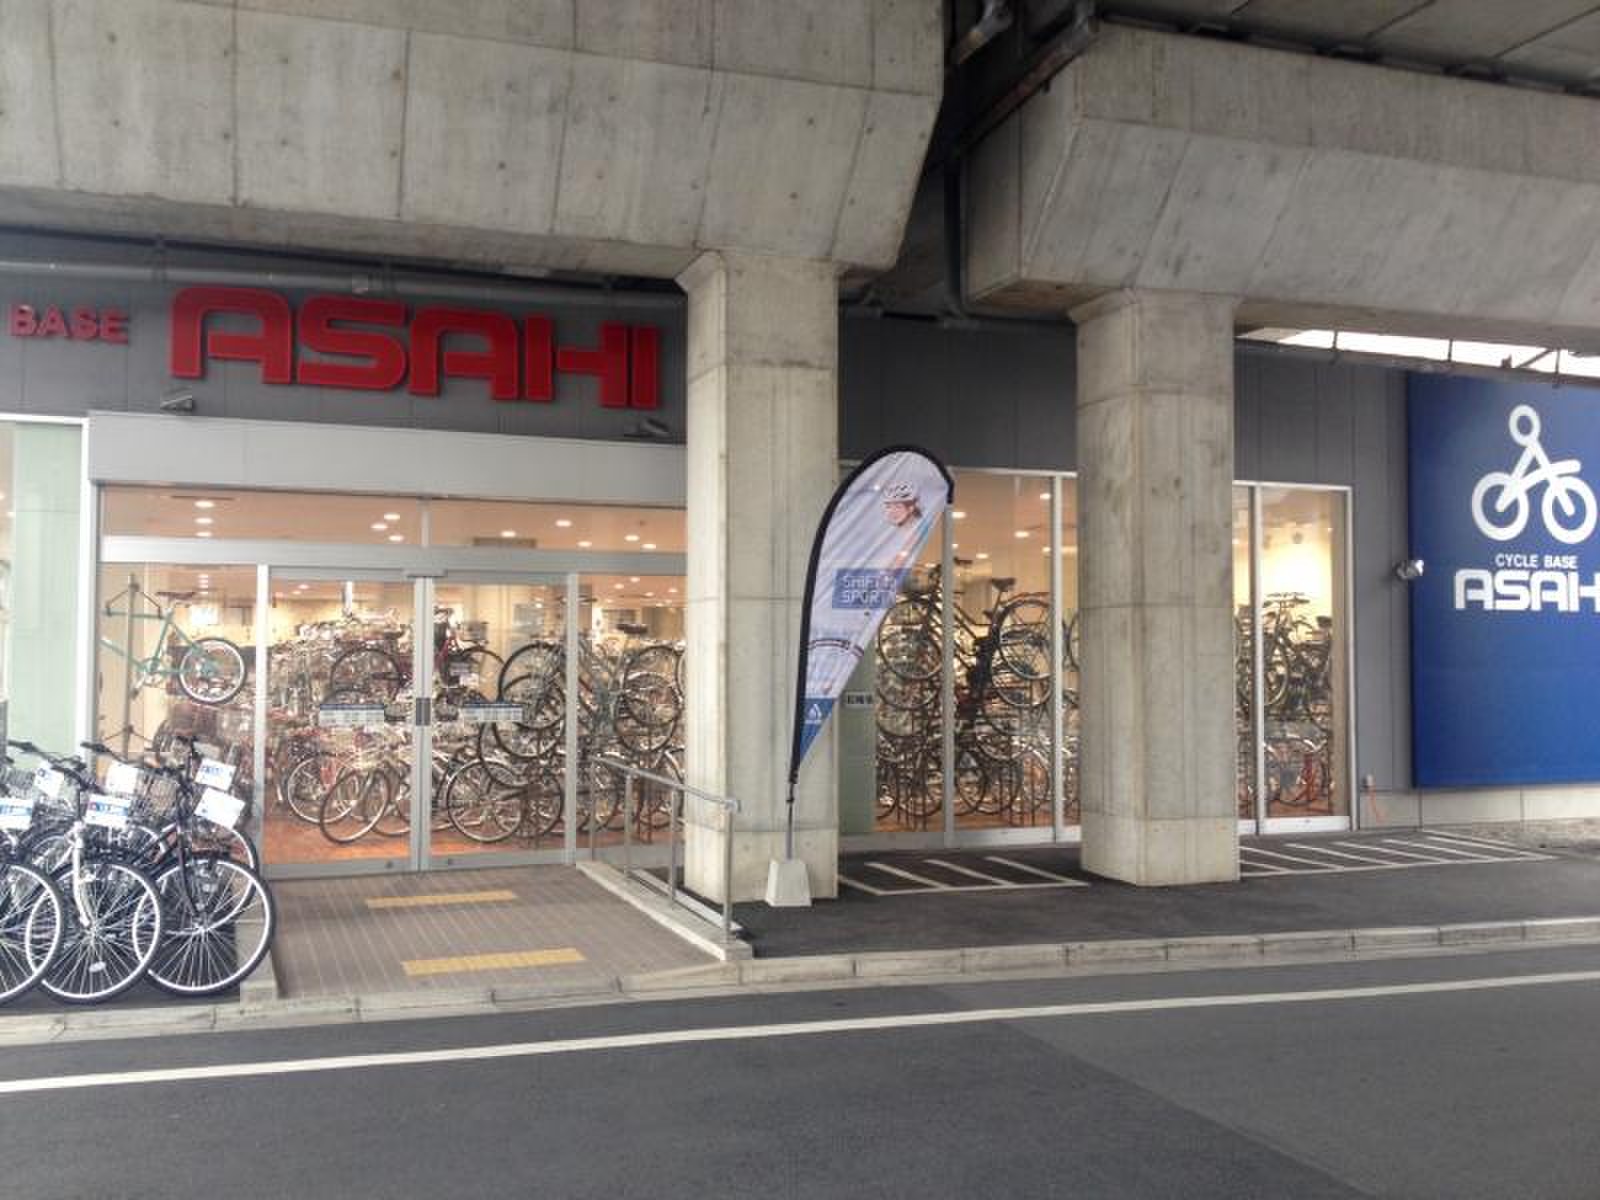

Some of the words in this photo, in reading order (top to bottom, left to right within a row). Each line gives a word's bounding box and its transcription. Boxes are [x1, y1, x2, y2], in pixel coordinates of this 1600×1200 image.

[10, 304, 128, 345] BASE
[170, 286, 658, 408] ASAHI
[1495, 553, 1538, 569] CYCLE
[1543, 554, 1578, 569] BASE
